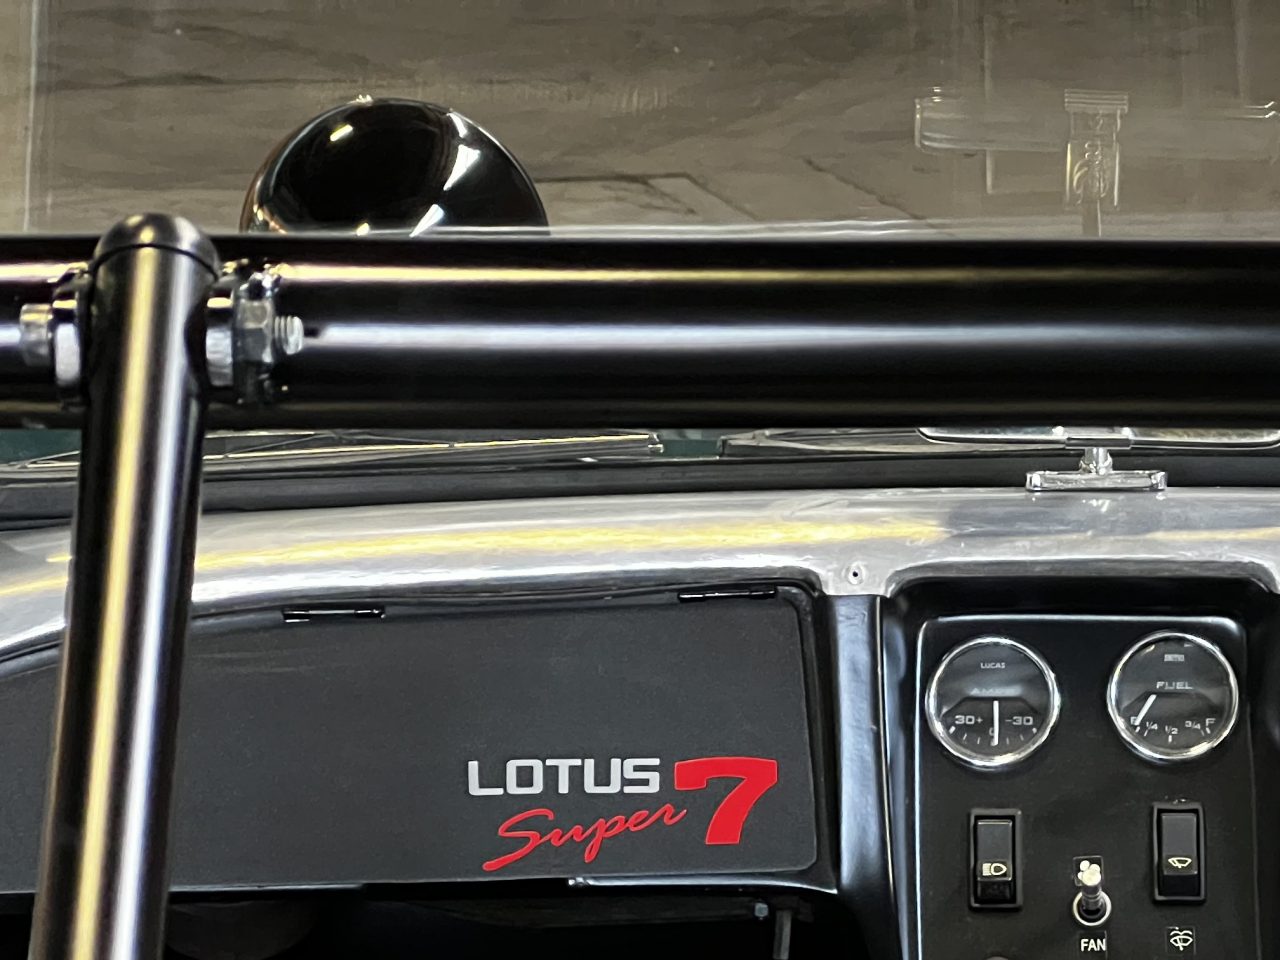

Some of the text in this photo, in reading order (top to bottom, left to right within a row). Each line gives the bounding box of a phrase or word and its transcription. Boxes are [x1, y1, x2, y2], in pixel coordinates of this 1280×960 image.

[1156, 681, 1193, 690] FUEL
[1205, 718, 1216, 726] F
[468, 756, 778, 845] LOTUS 7
[481, 803, 687, 872] Super
[1080, 938, 1106, 952] FAN
